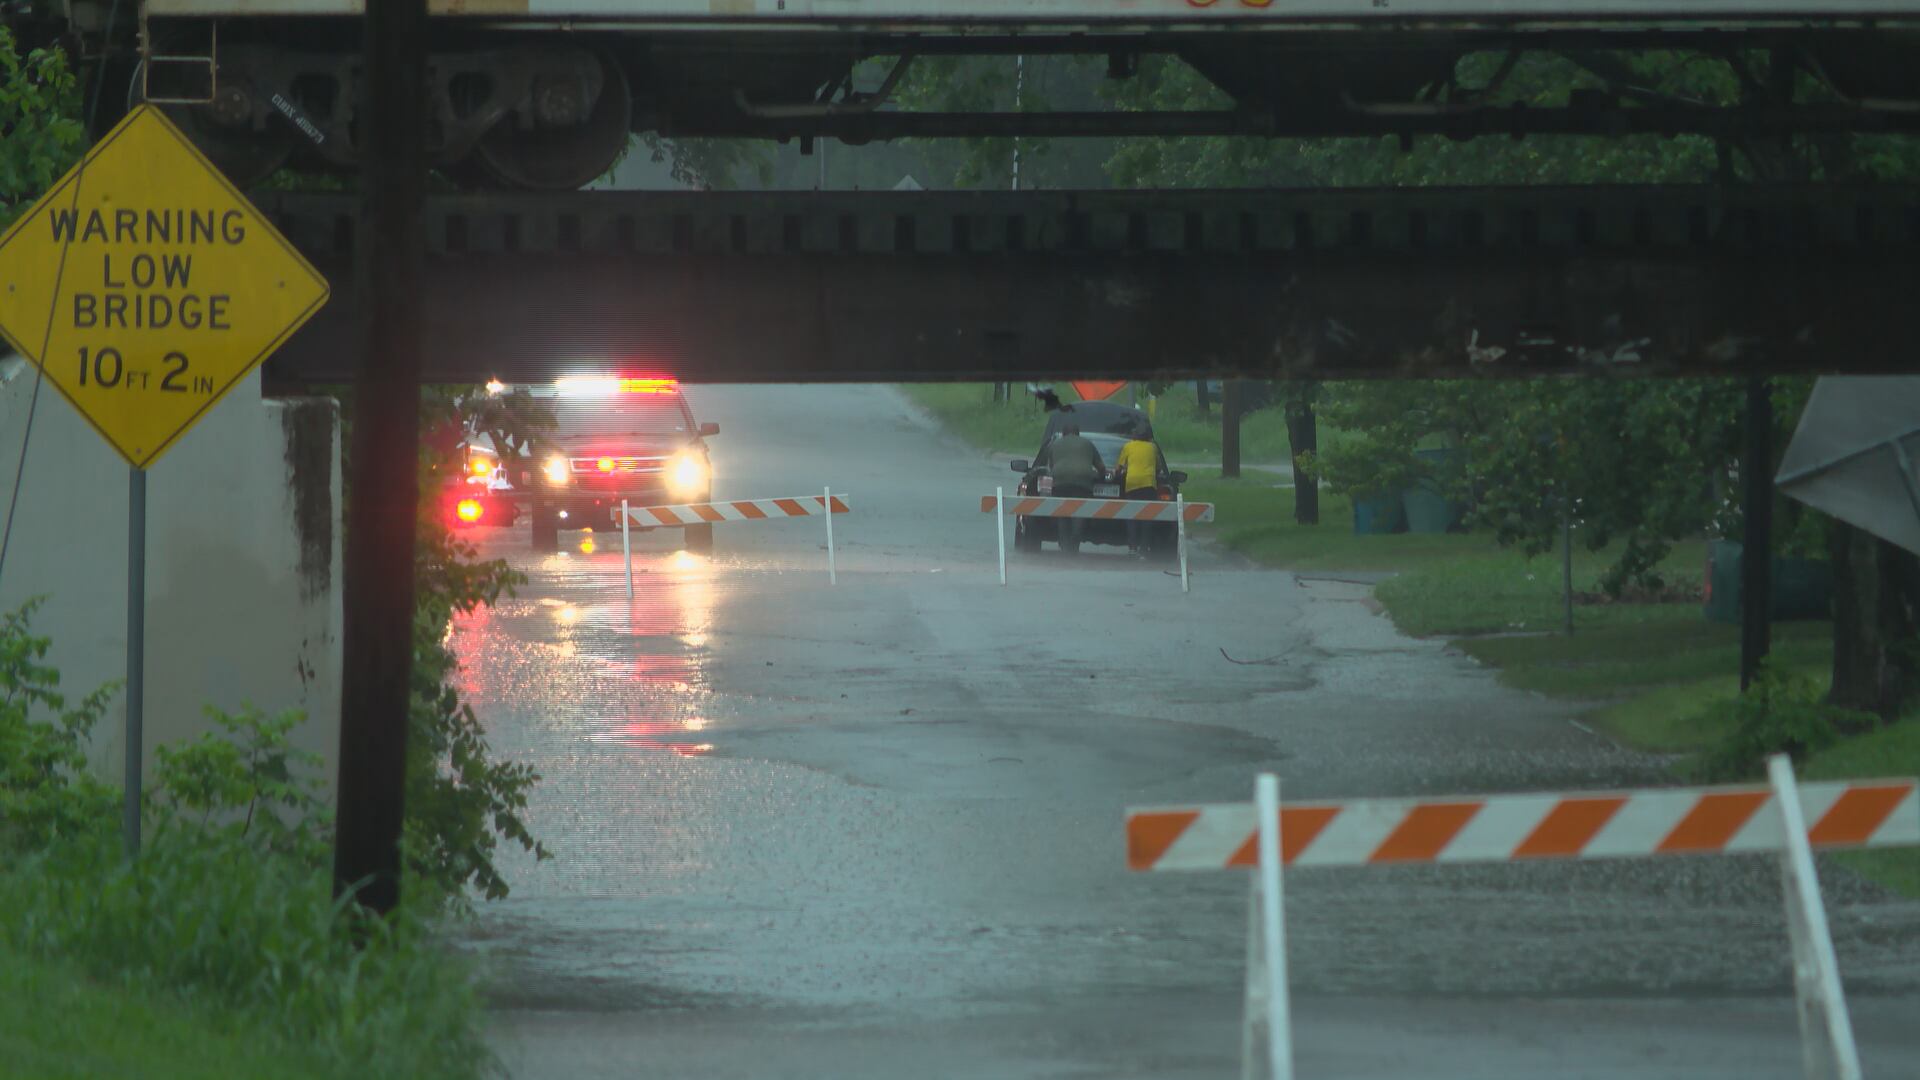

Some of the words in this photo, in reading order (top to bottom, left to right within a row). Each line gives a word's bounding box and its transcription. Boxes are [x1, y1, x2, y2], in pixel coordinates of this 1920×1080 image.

[50, 208, 245, 245] WARNING
[103, 253, 192, 289] LOW
[73, 294, 231, 330] BRIDGE
[78, 346, 123, 388] 10
[126, 371, 150, 390] FT
[160, 351, 189, 393] 2
[193, 375, 214, 394] IN
